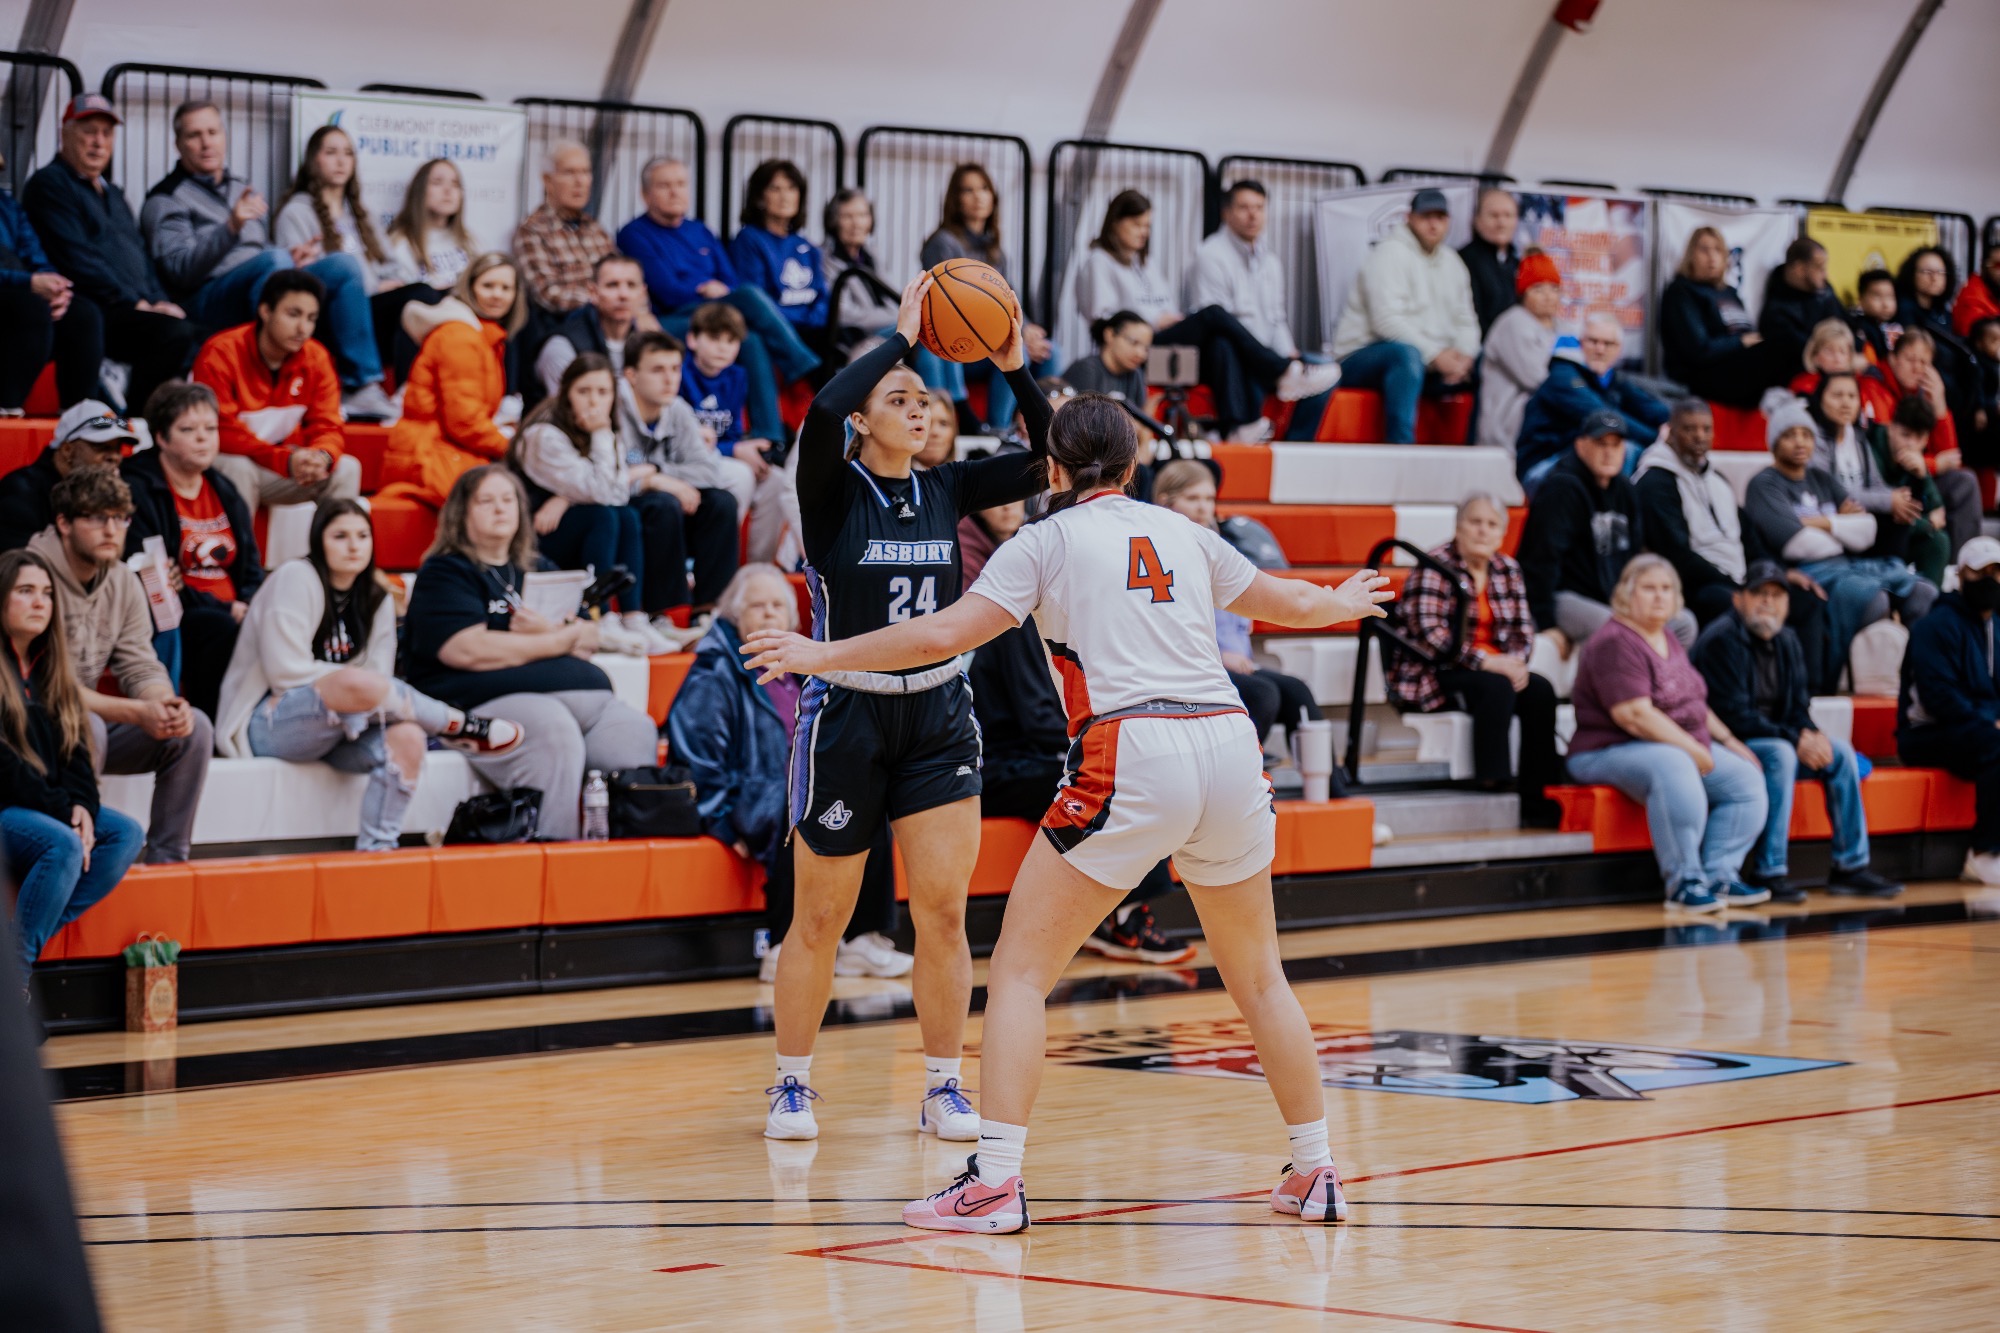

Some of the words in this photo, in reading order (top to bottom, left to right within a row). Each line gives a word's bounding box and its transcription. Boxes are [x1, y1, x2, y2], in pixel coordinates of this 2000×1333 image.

[358, 115, 436, 134] CLERMONT
[439, 121, 499, 139] COUNTY
[358, 137, 419, 158] PUBLIC
[427, 143, 499, 162] LIBRARY
[865, 542, 952, 563] ASBURY
[1126, 536, 1175, 603] 4
[888, 576, 938, 624] 24
